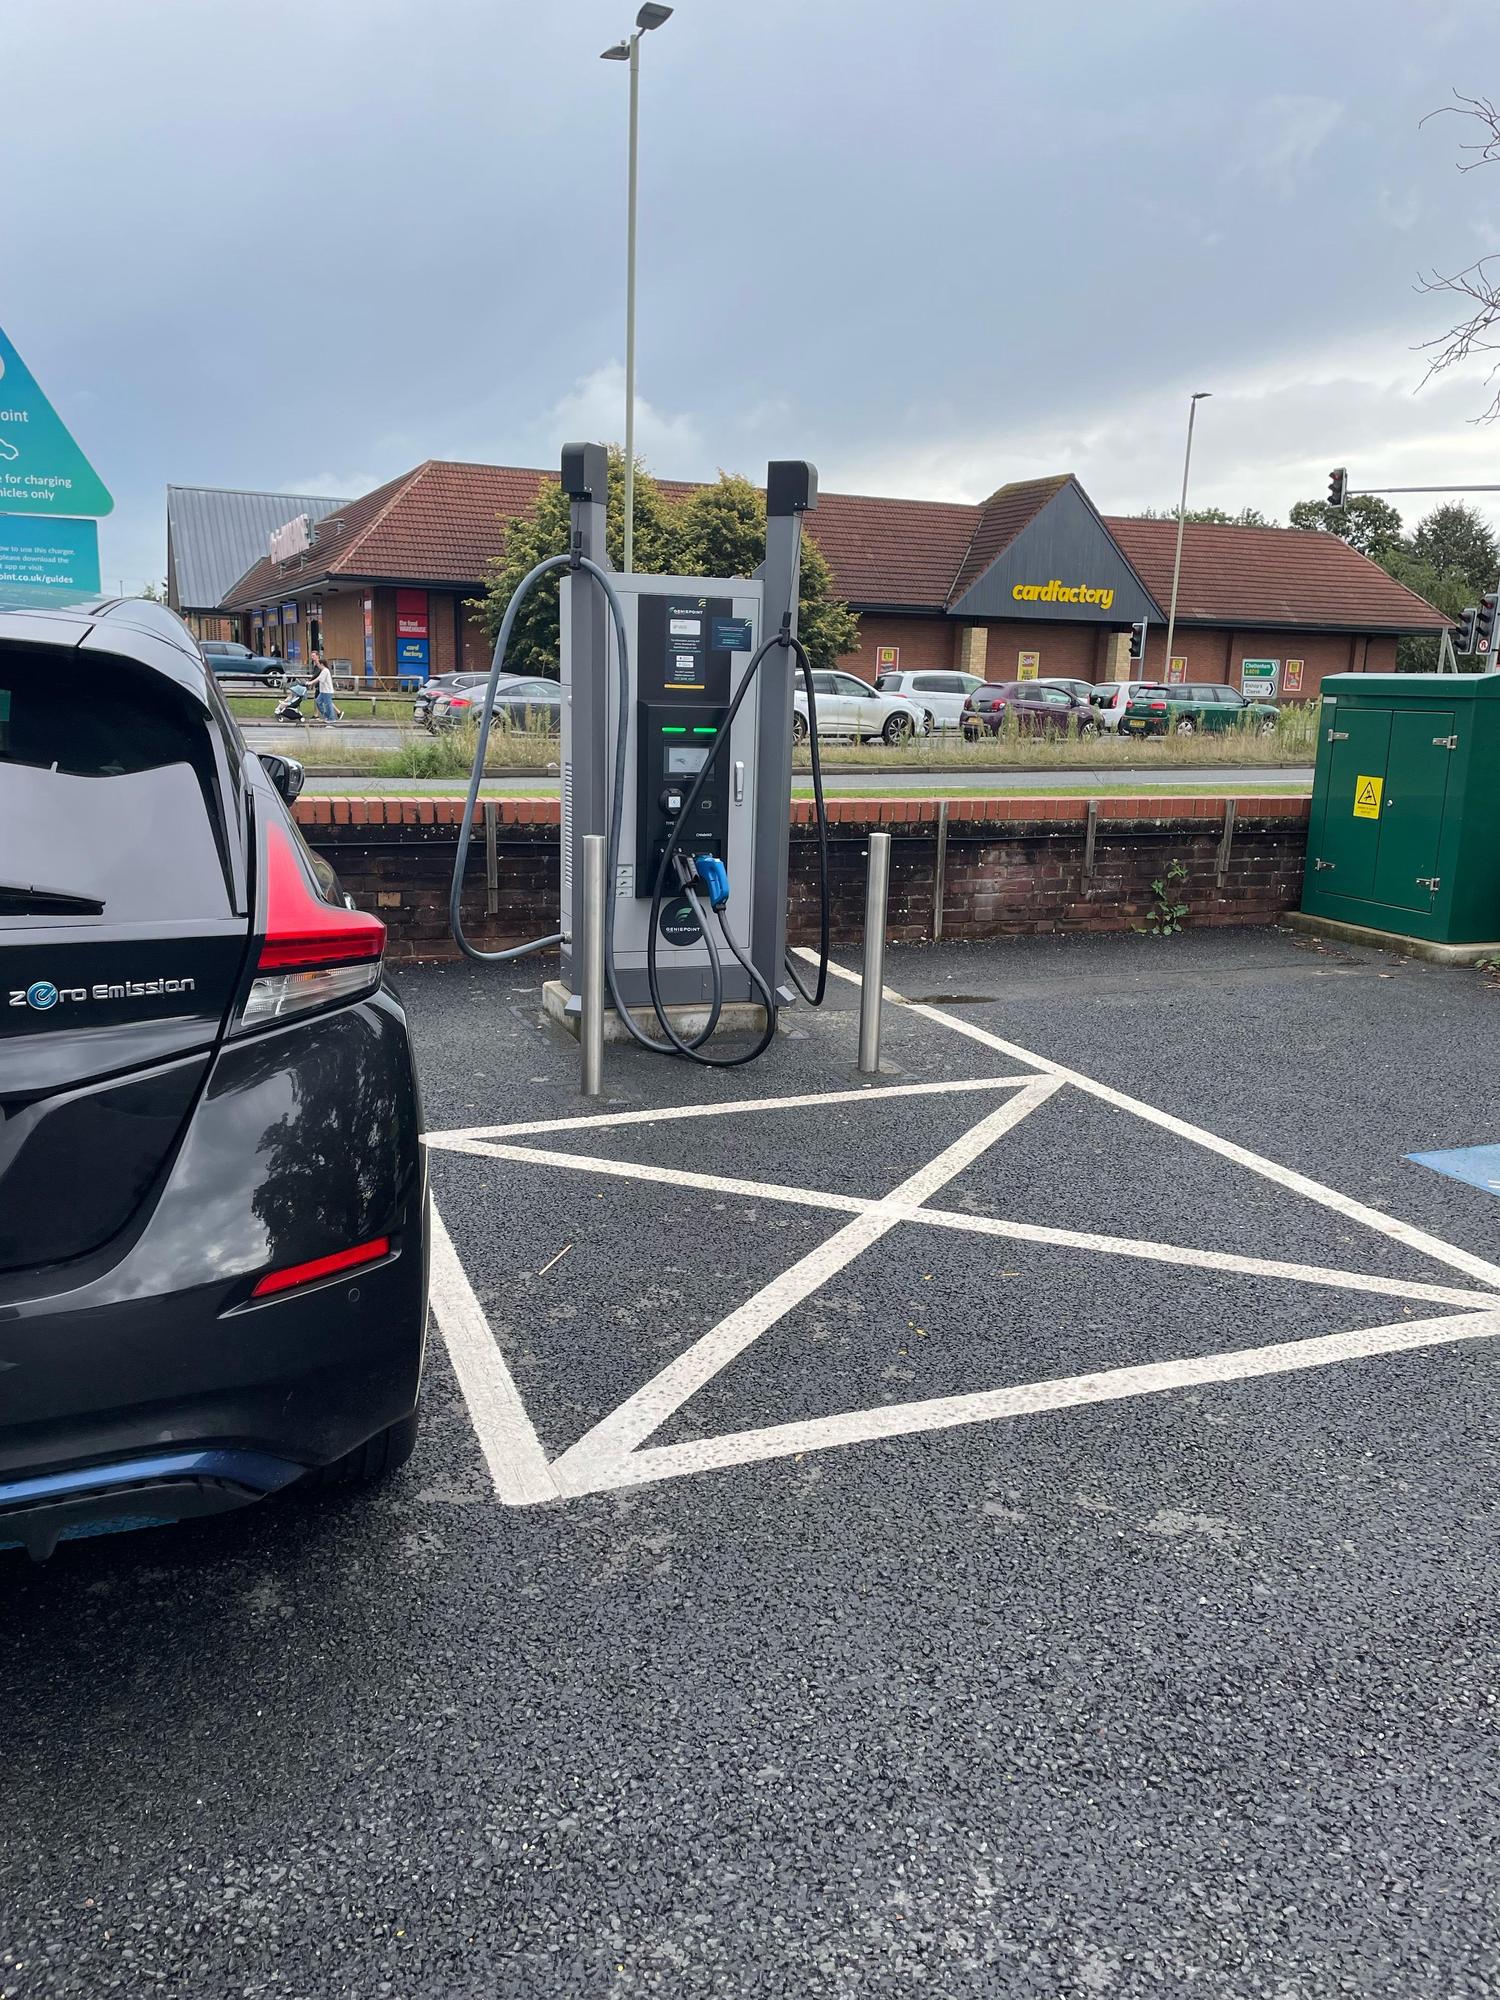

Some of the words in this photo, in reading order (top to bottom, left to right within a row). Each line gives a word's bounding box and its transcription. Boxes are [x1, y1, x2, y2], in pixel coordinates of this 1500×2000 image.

[0, 409, 29, 422] oint
[5, 473, 22, 484] for
[24, 474, 72, 488] charging
[31, 489, 55, 501] only
[1012, 580, 1114, 610] cardfactory
[92, 978, 196, 1000] Emission
